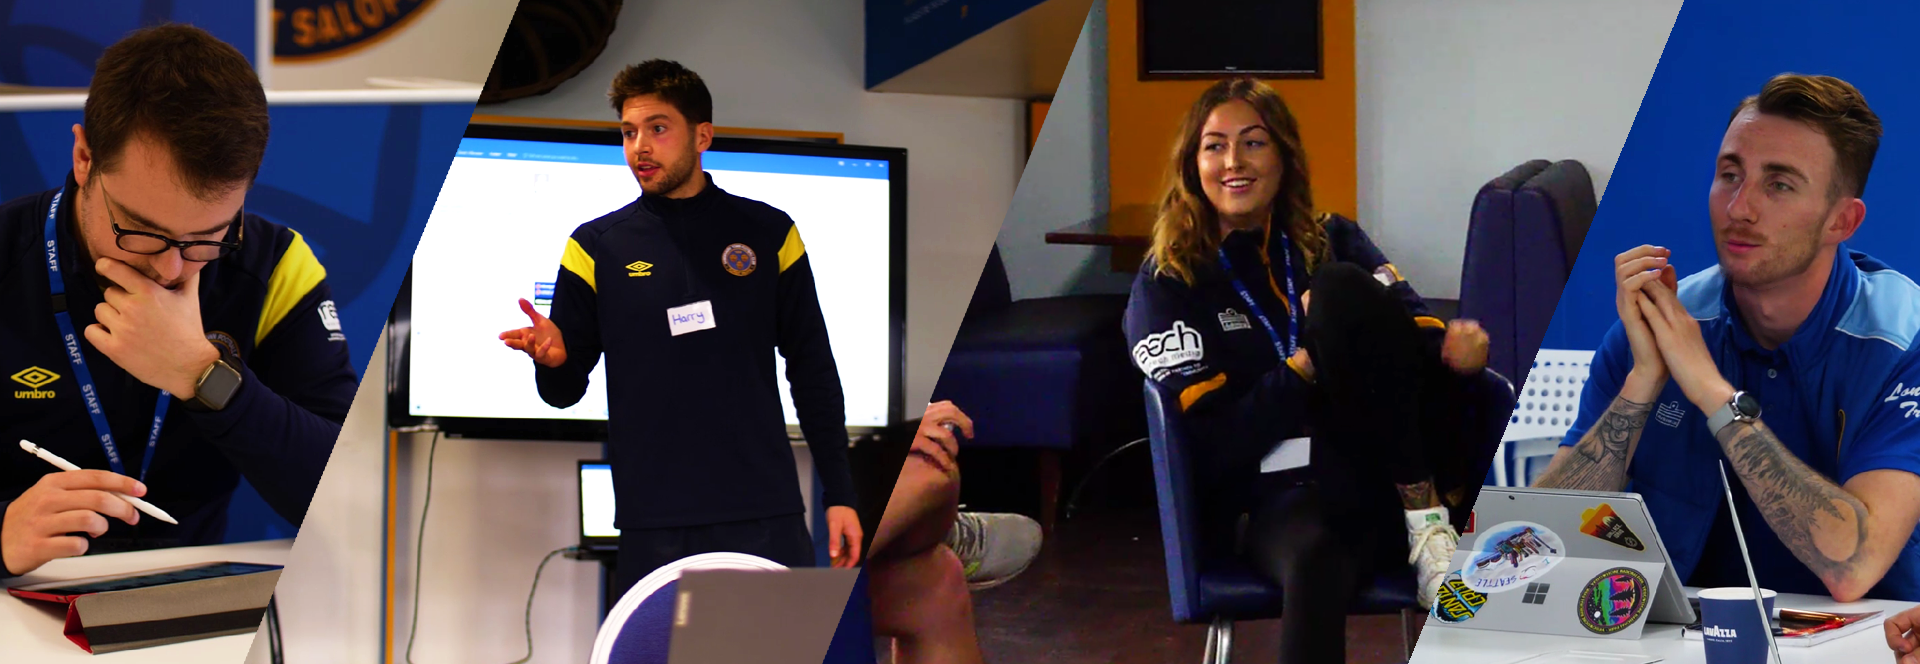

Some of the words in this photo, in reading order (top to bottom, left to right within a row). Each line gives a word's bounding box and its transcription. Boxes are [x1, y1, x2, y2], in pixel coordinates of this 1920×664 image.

[49, 192, 63, 220] STAFF
[46, 239, 59, 273] STAFF
[671, 311, 706, 326] Harry
[65, 333, 83, 365] STAFF
[1134, 324, 1200, 364] each
[14, 390, 56, 399] umbro
[82, 384, 101, 415] STAFF
[148, 415, 162, 447] STAFF
[101, 433, 120, 464] STAFF
[1449, 580, 1487, 607] CRUZ
[1474, 575, 1518, 588] SEATTLE
[1438, 585, 1475, 619] SANTA
[1703, 624, 1738, 638] LAVAZZA
